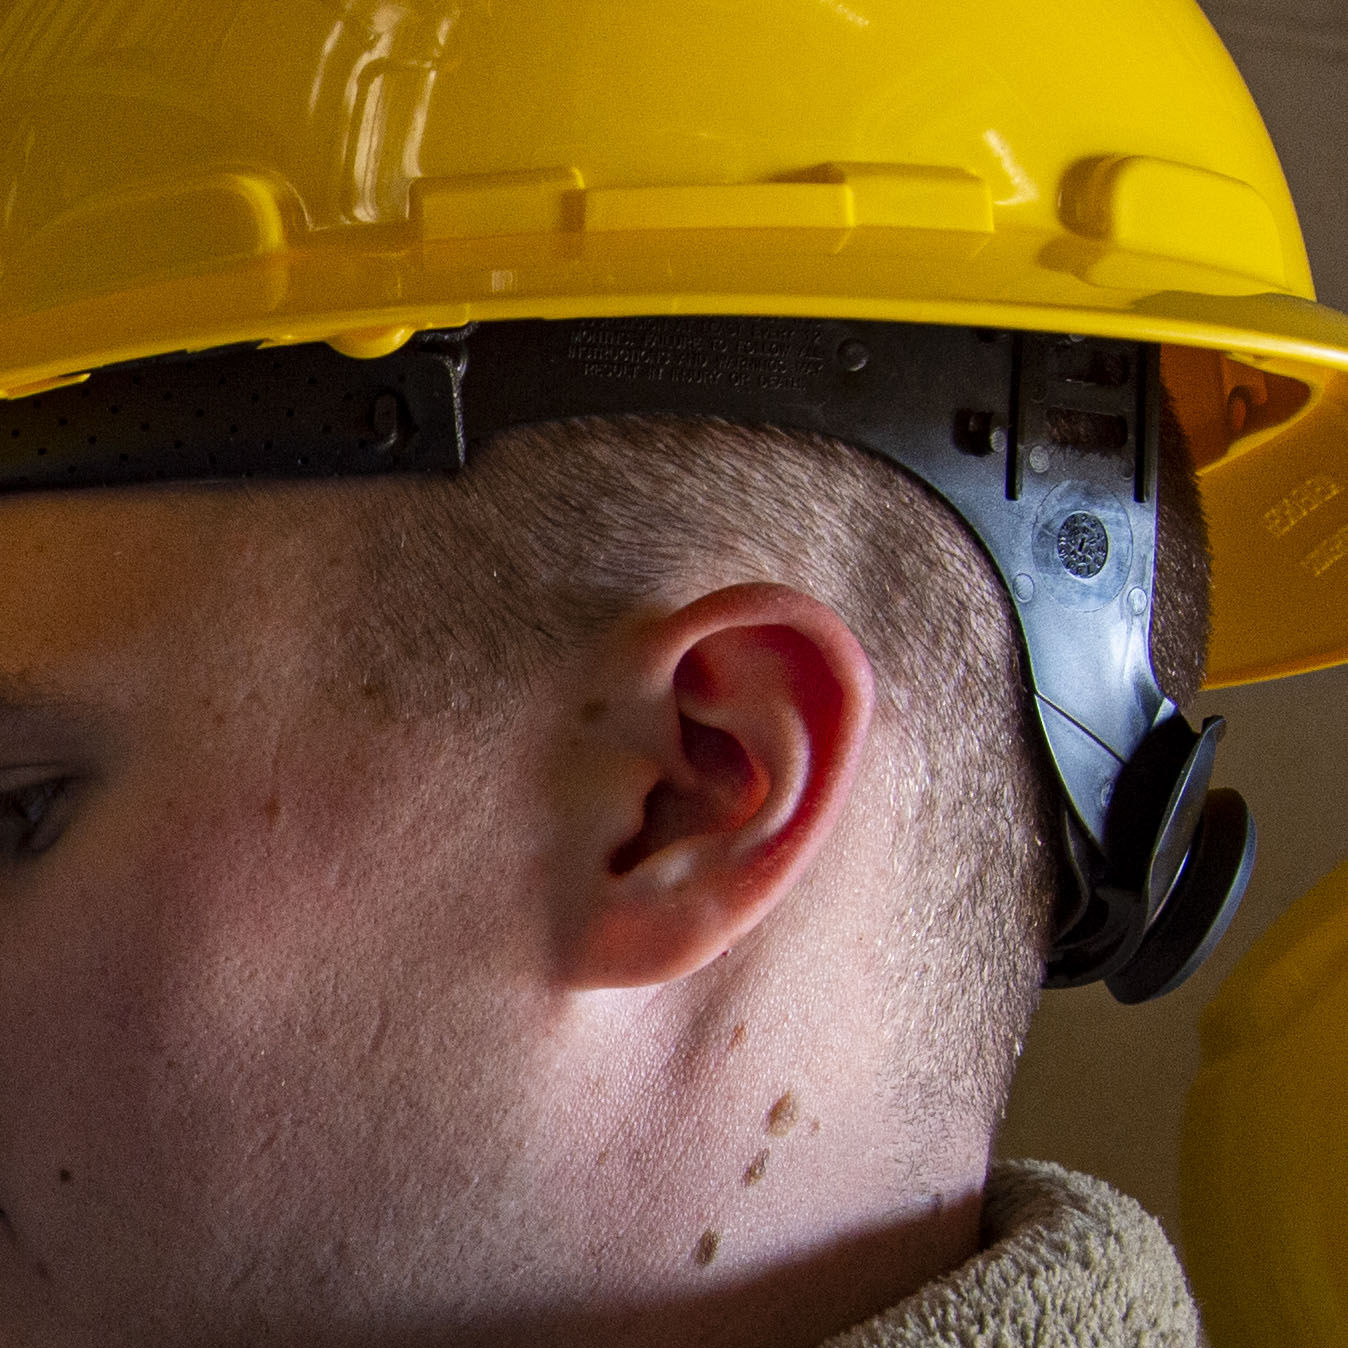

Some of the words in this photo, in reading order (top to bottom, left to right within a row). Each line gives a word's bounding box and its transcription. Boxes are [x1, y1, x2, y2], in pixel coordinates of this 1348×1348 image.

[567, 346, 672, 365] INSTRUCTIONS
[678, 354, 709, 368] AND
[644, 335, 703, 350] FAILURE
[712, 339, 727, 353] TO
[738, 341, 792, 357] FOLLOW
[584, 363, 641, 379] RESULT
[671, 370, 723, 385] INJURY
